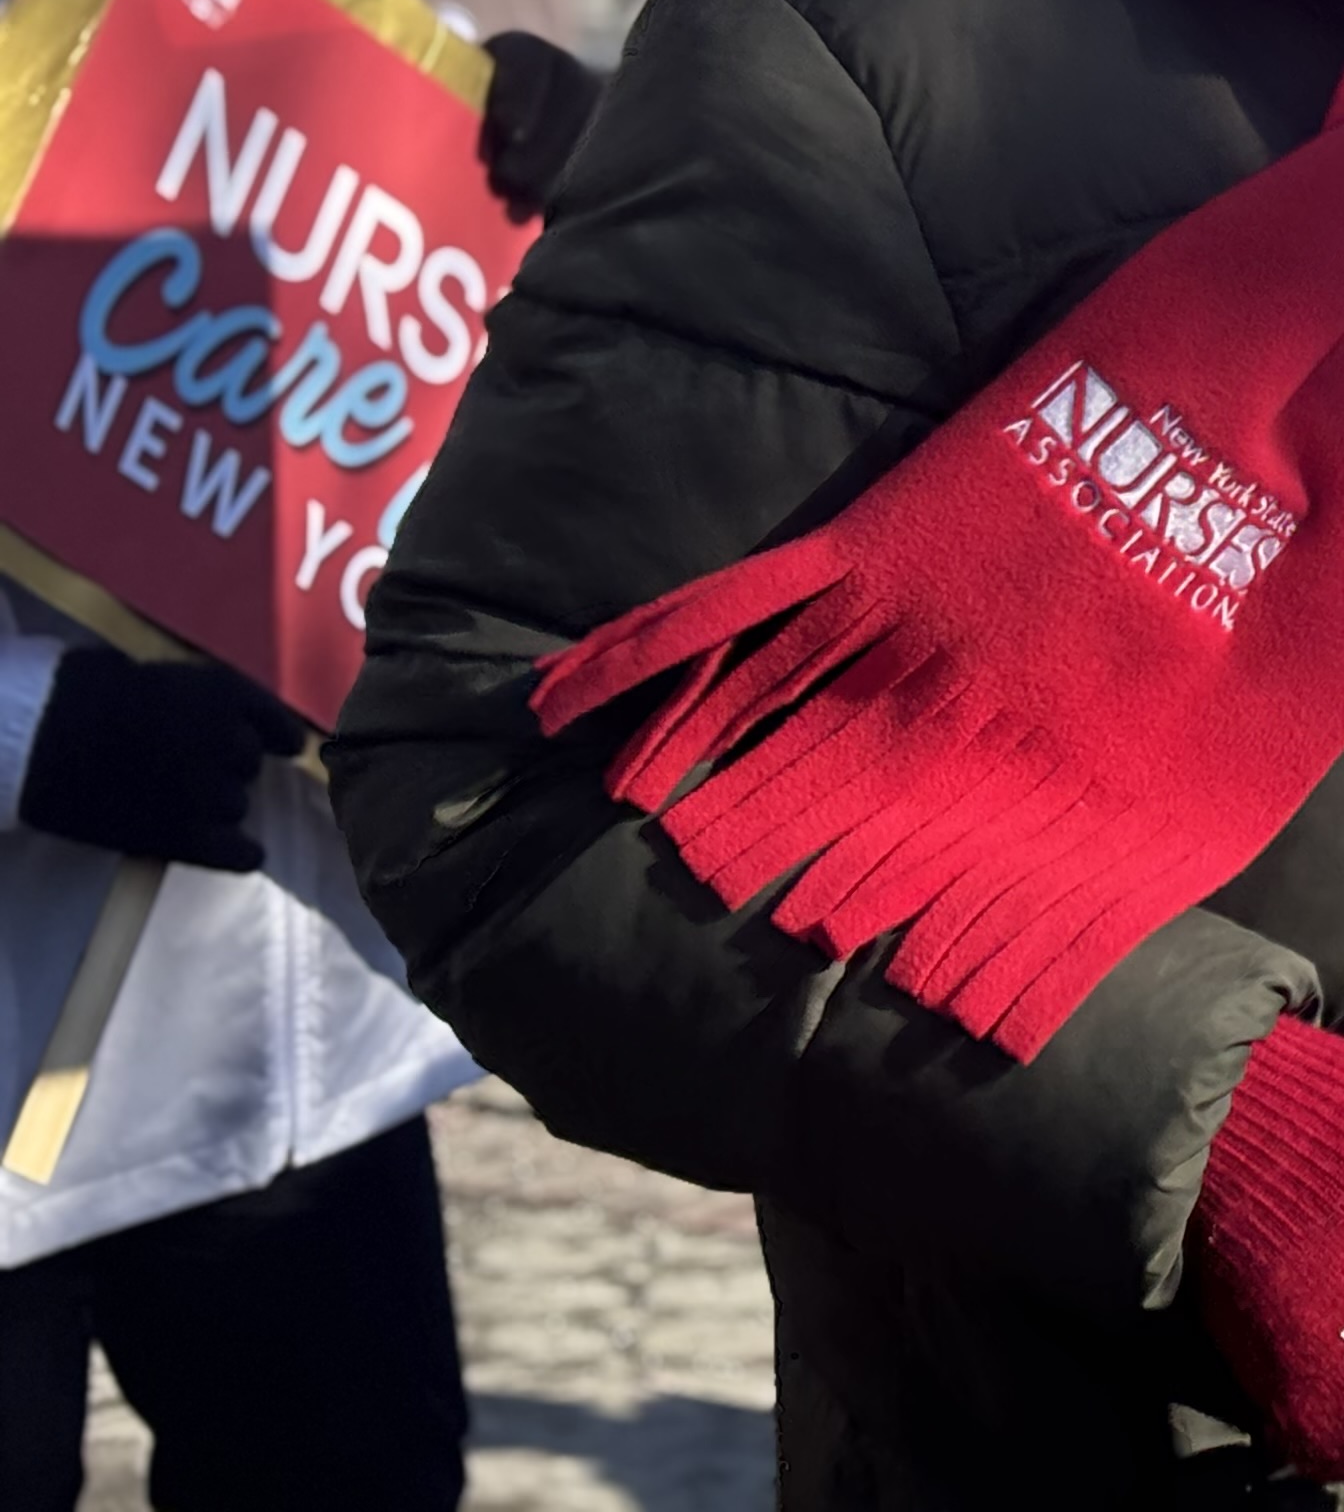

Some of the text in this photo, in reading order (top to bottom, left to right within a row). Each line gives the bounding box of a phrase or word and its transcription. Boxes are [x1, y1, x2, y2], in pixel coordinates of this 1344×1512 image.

[156, 68, 512, 384] NURS
[55, 354, 271, 537] NEW
[79, 228, 411, 468] Care
[1003, 418, 1240, 630] ASSOCIATION
[1031, 359, 1285, 590] NURSES
[1150, 404, 1297, 538] New York State
